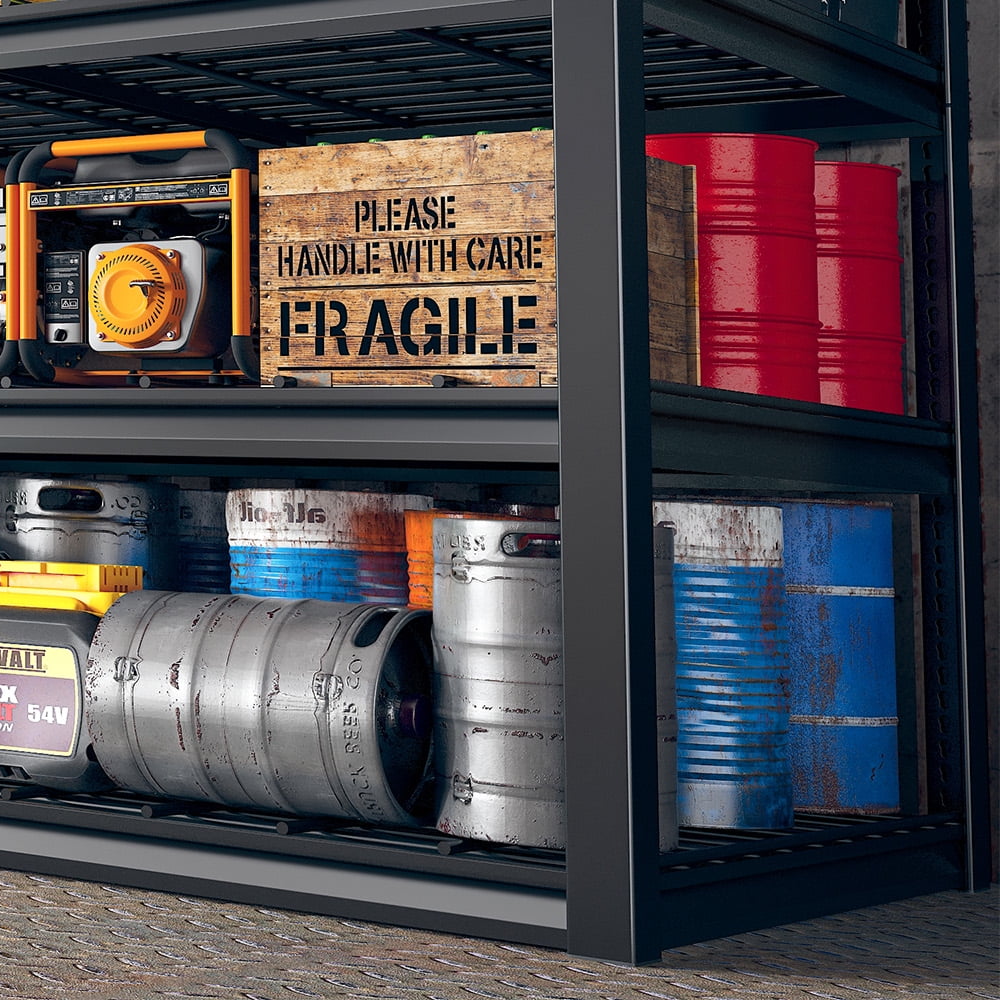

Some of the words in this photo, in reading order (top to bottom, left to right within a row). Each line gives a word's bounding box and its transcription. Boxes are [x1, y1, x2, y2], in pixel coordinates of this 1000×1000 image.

[354, 195, 457, 233] PLEASE
[278, 241, 381, 278] HANDLE
[389, 238, 458, 274] WITH
[466, 234, 543, 271] CARE
[279, 295, 539, 357] FRAGILE
[27, 704, 69, 725] 54V
